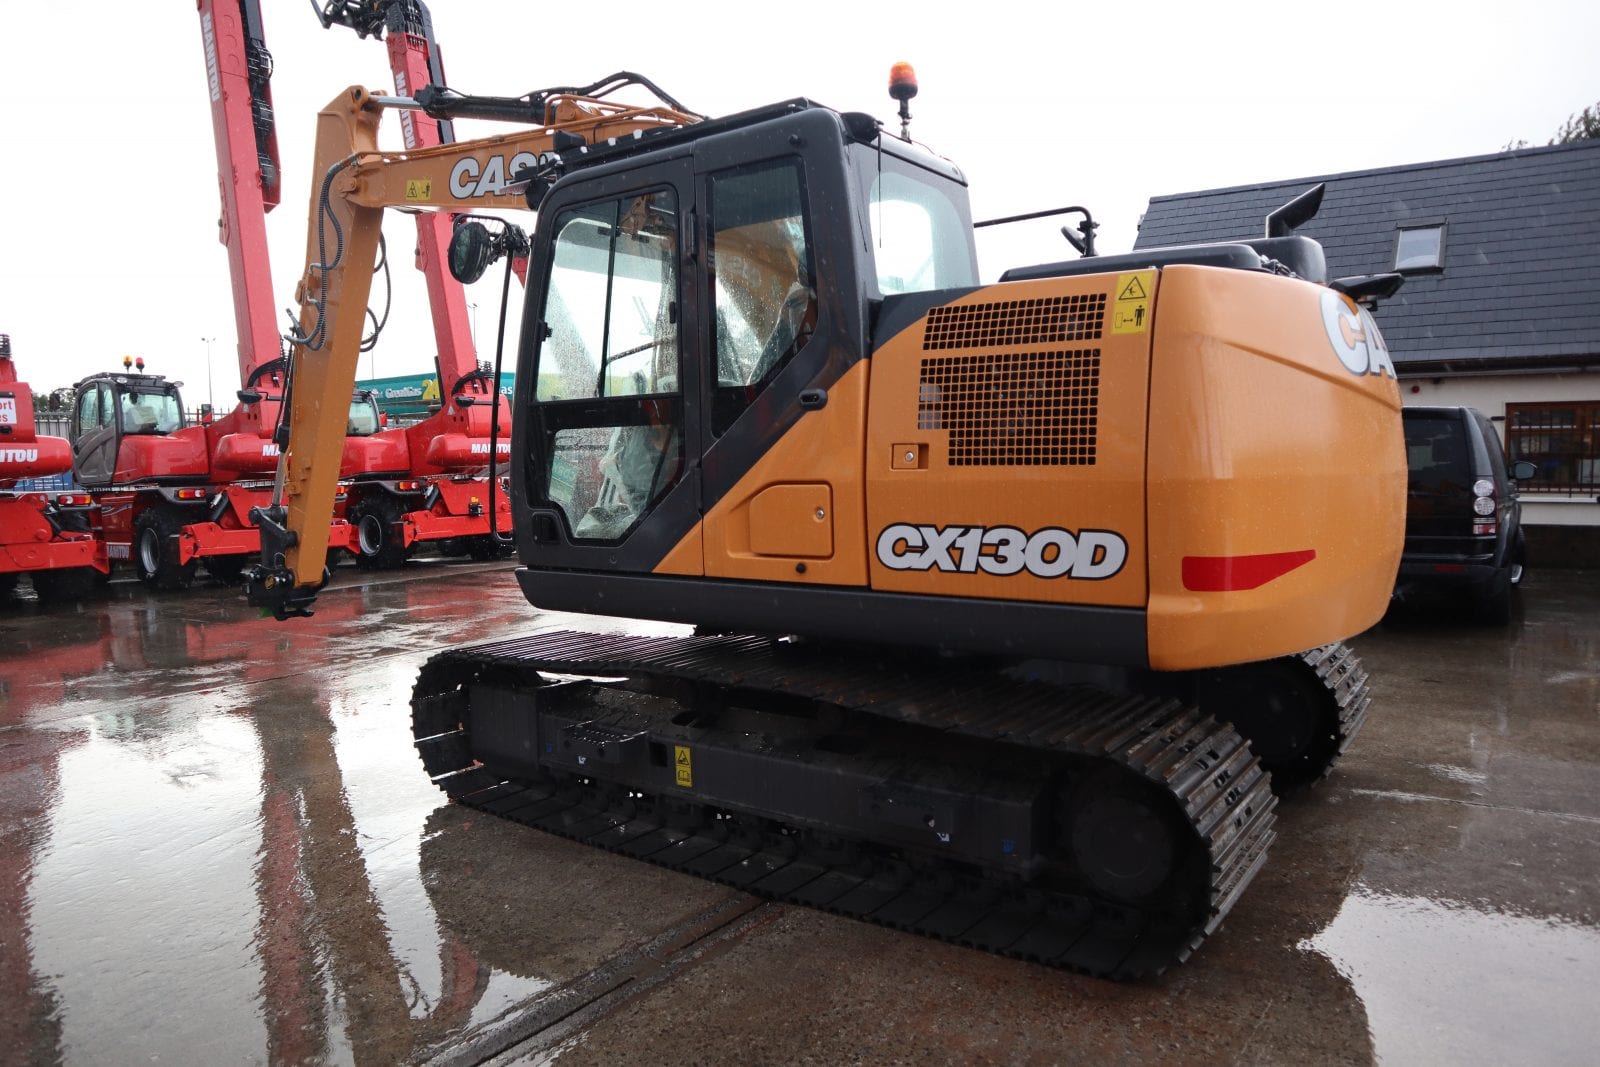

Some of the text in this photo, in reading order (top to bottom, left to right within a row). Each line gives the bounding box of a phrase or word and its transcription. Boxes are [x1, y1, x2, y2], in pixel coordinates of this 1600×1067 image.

[202, 12, 220, 102] MANITOU
[449, 151, 559, 199] CAS
[876, 522, 1129, 581] CX130D
